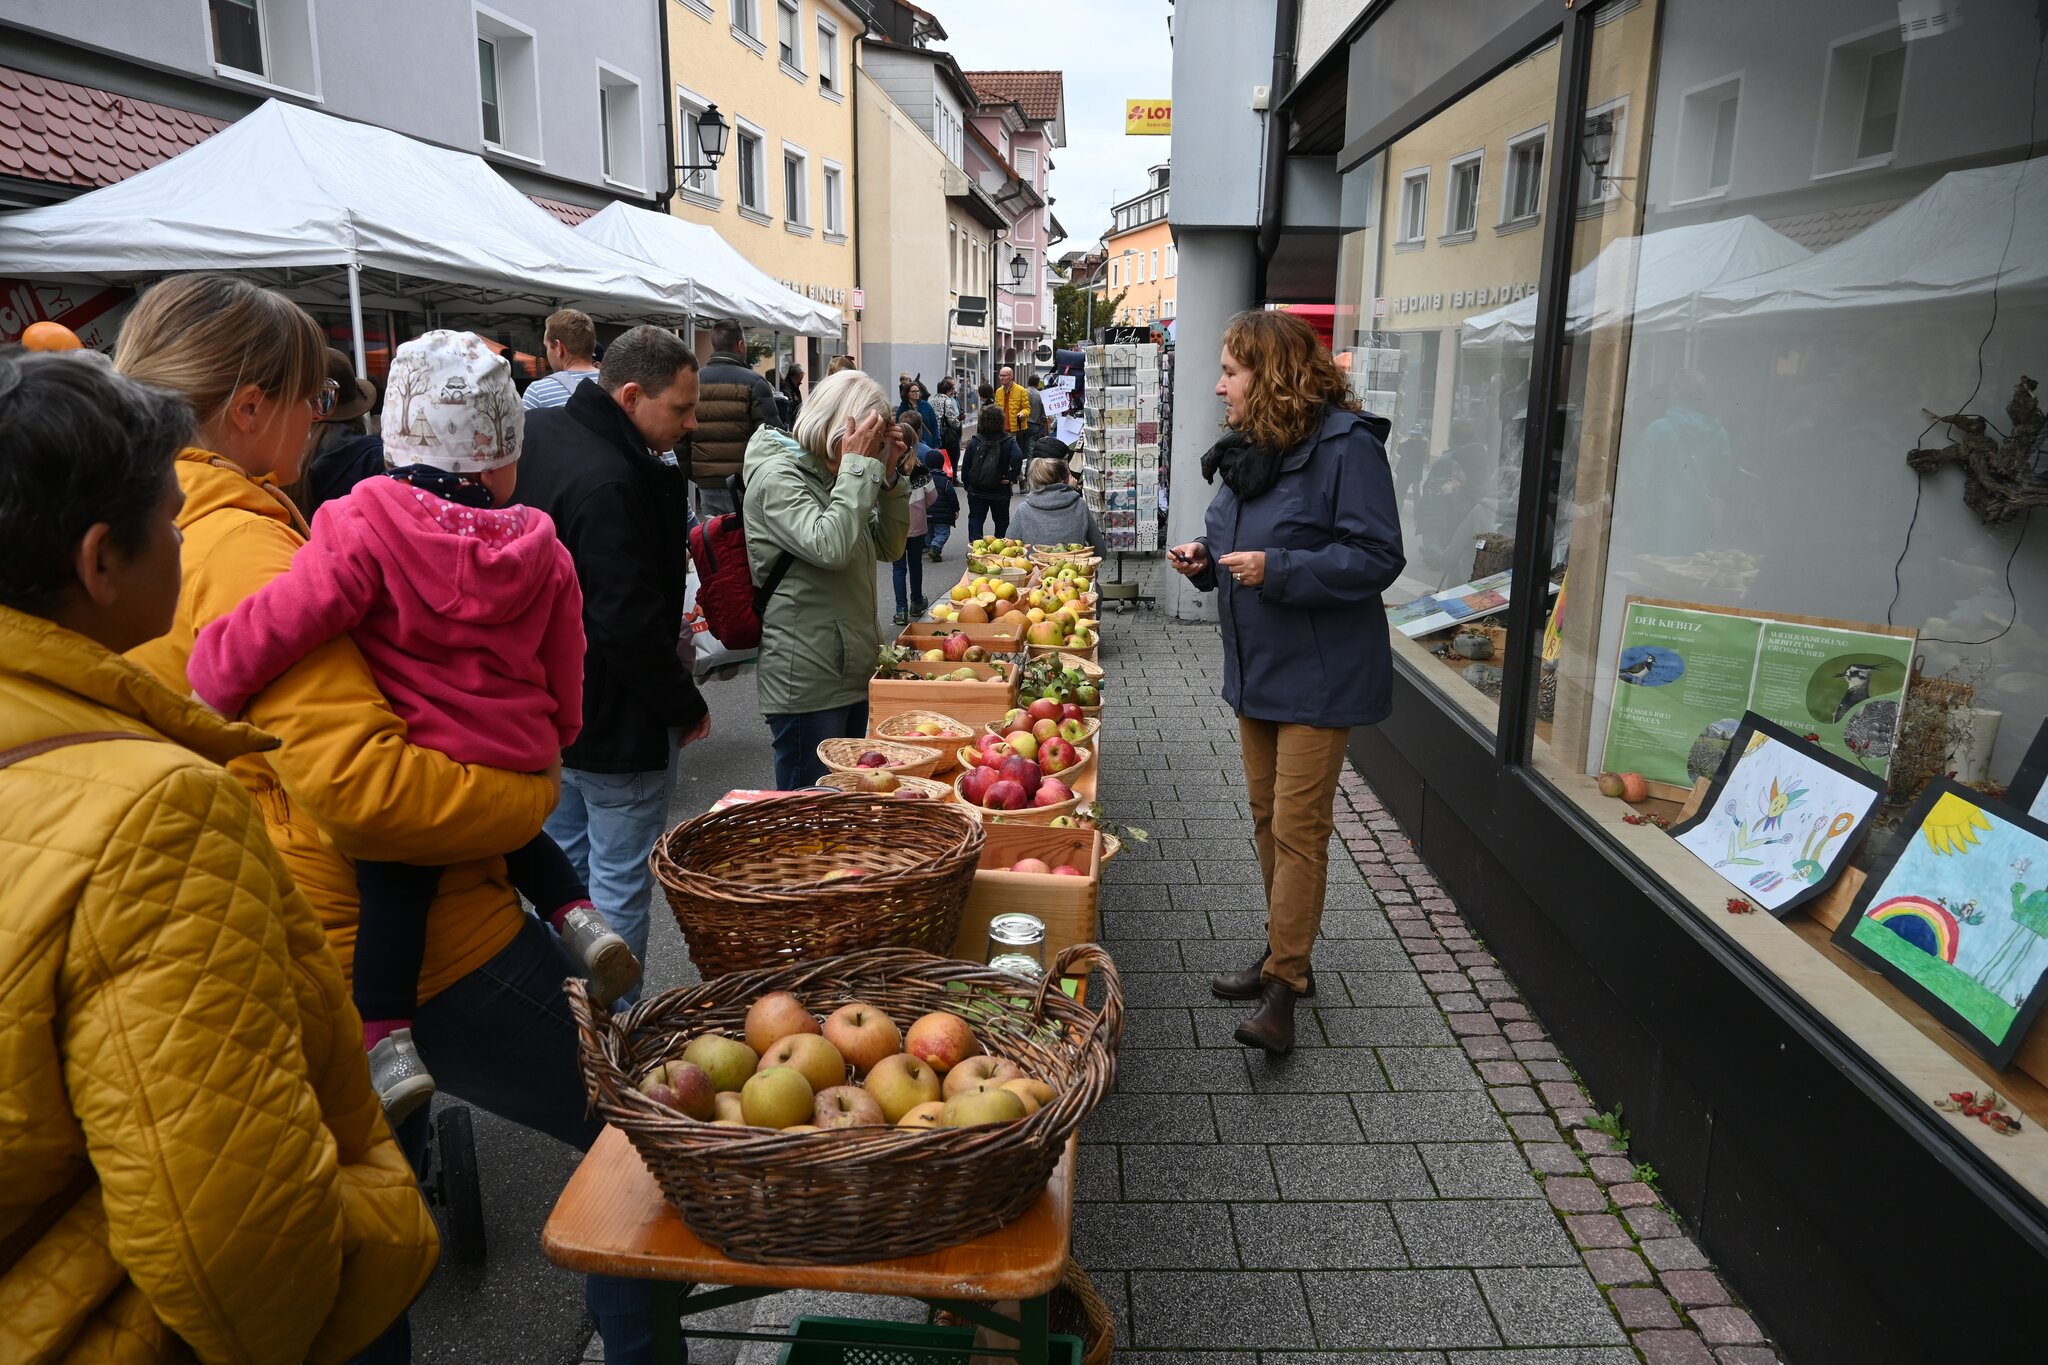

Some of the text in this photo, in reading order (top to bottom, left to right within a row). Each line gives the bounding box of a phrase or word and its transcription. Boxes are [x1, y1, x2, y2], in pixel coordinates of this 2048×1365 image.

[808, 283, 845, 304] BINDER
[1635, 616, 1702, 632] DER KIEBITZ
[1806, 650, 1825, 658] RIED
